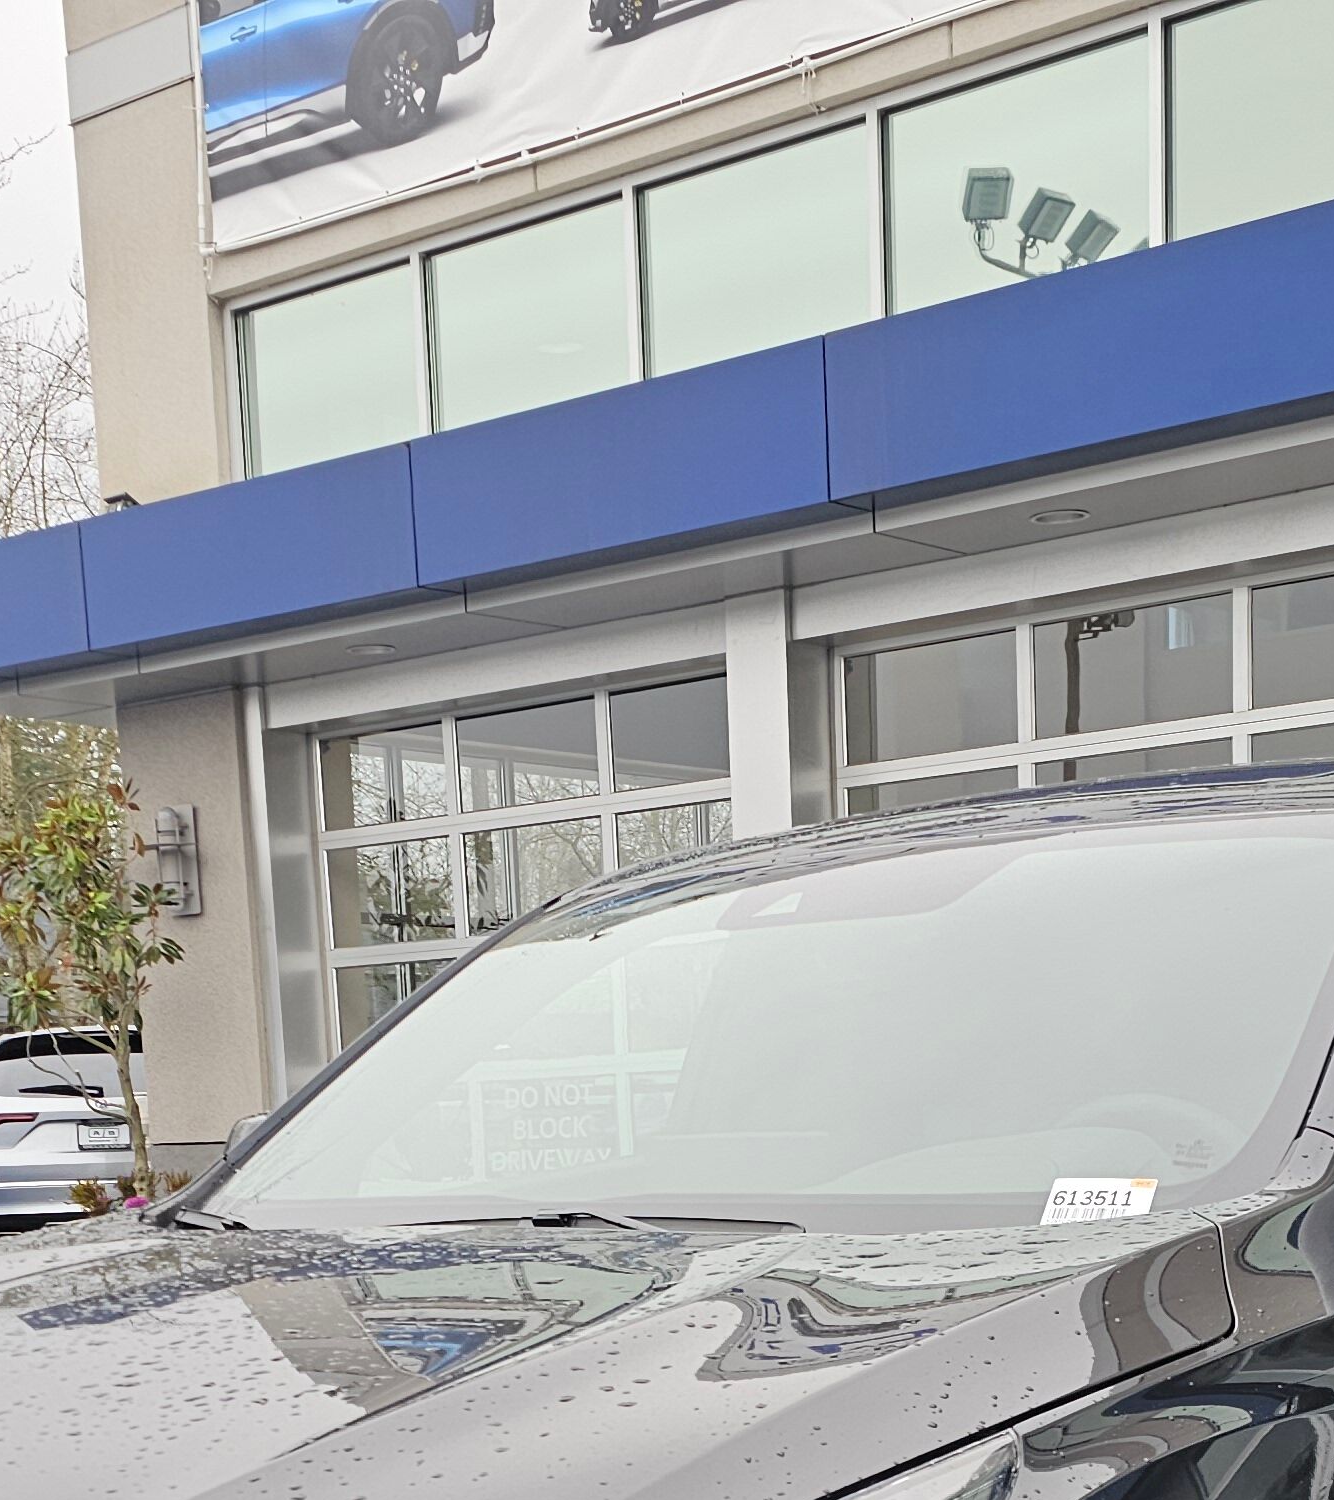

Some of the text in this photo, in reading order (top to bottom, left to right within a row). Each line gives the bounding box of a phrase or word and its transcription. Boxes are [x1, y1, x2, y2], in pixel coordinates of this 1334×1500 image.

[505, 1083, 594, 1109] DO NOT
[513, 1116, 588, 1140] BLOCK
[1052, 1190, 1133, 1206] 613511
